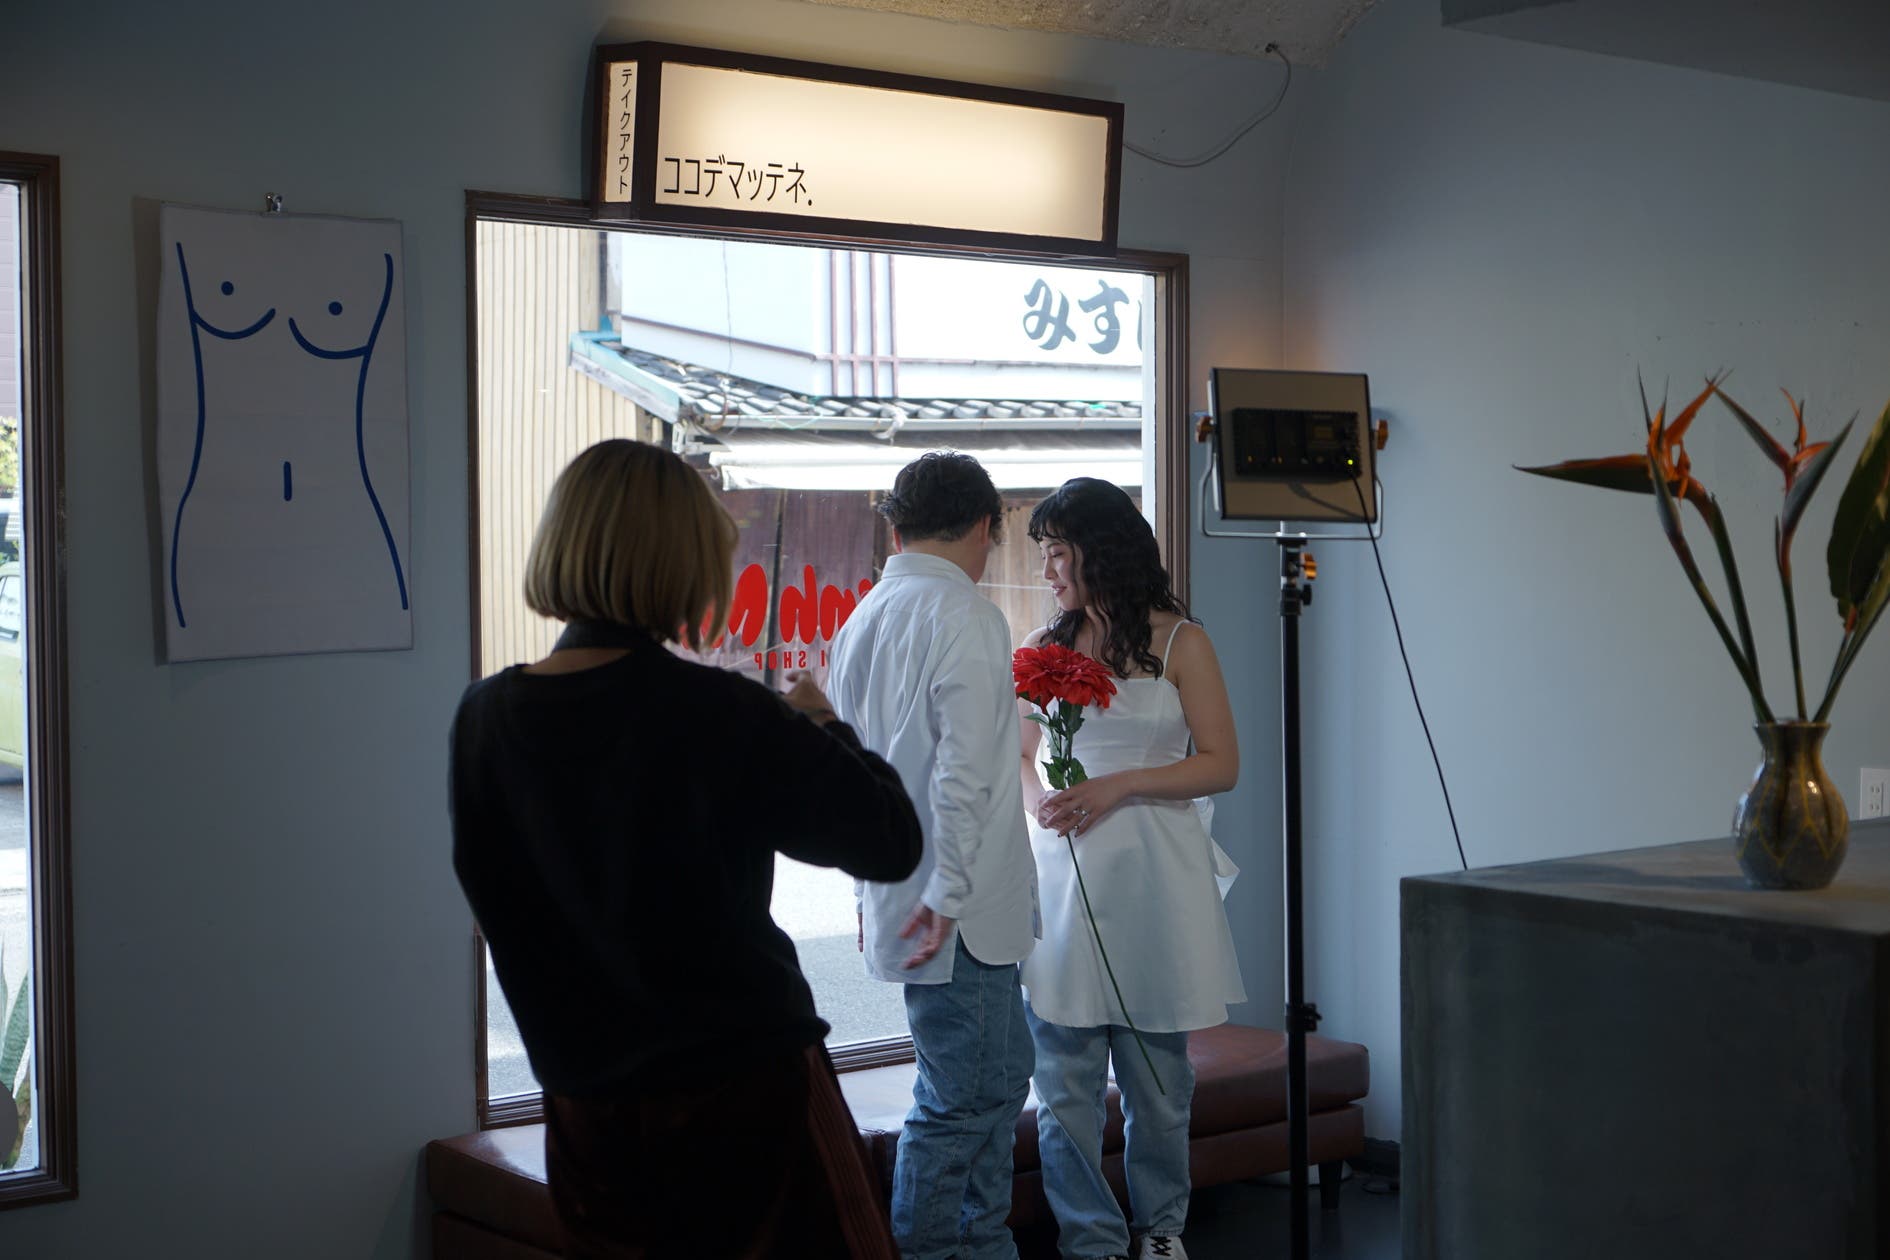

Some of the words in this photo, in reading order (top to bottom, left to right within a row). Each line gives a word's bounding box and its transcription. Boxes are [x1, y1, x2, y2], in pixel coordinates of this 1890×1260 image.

[618, 68, 632, 195] テイクアウト
[1023, 278, 1143, 355] みす
